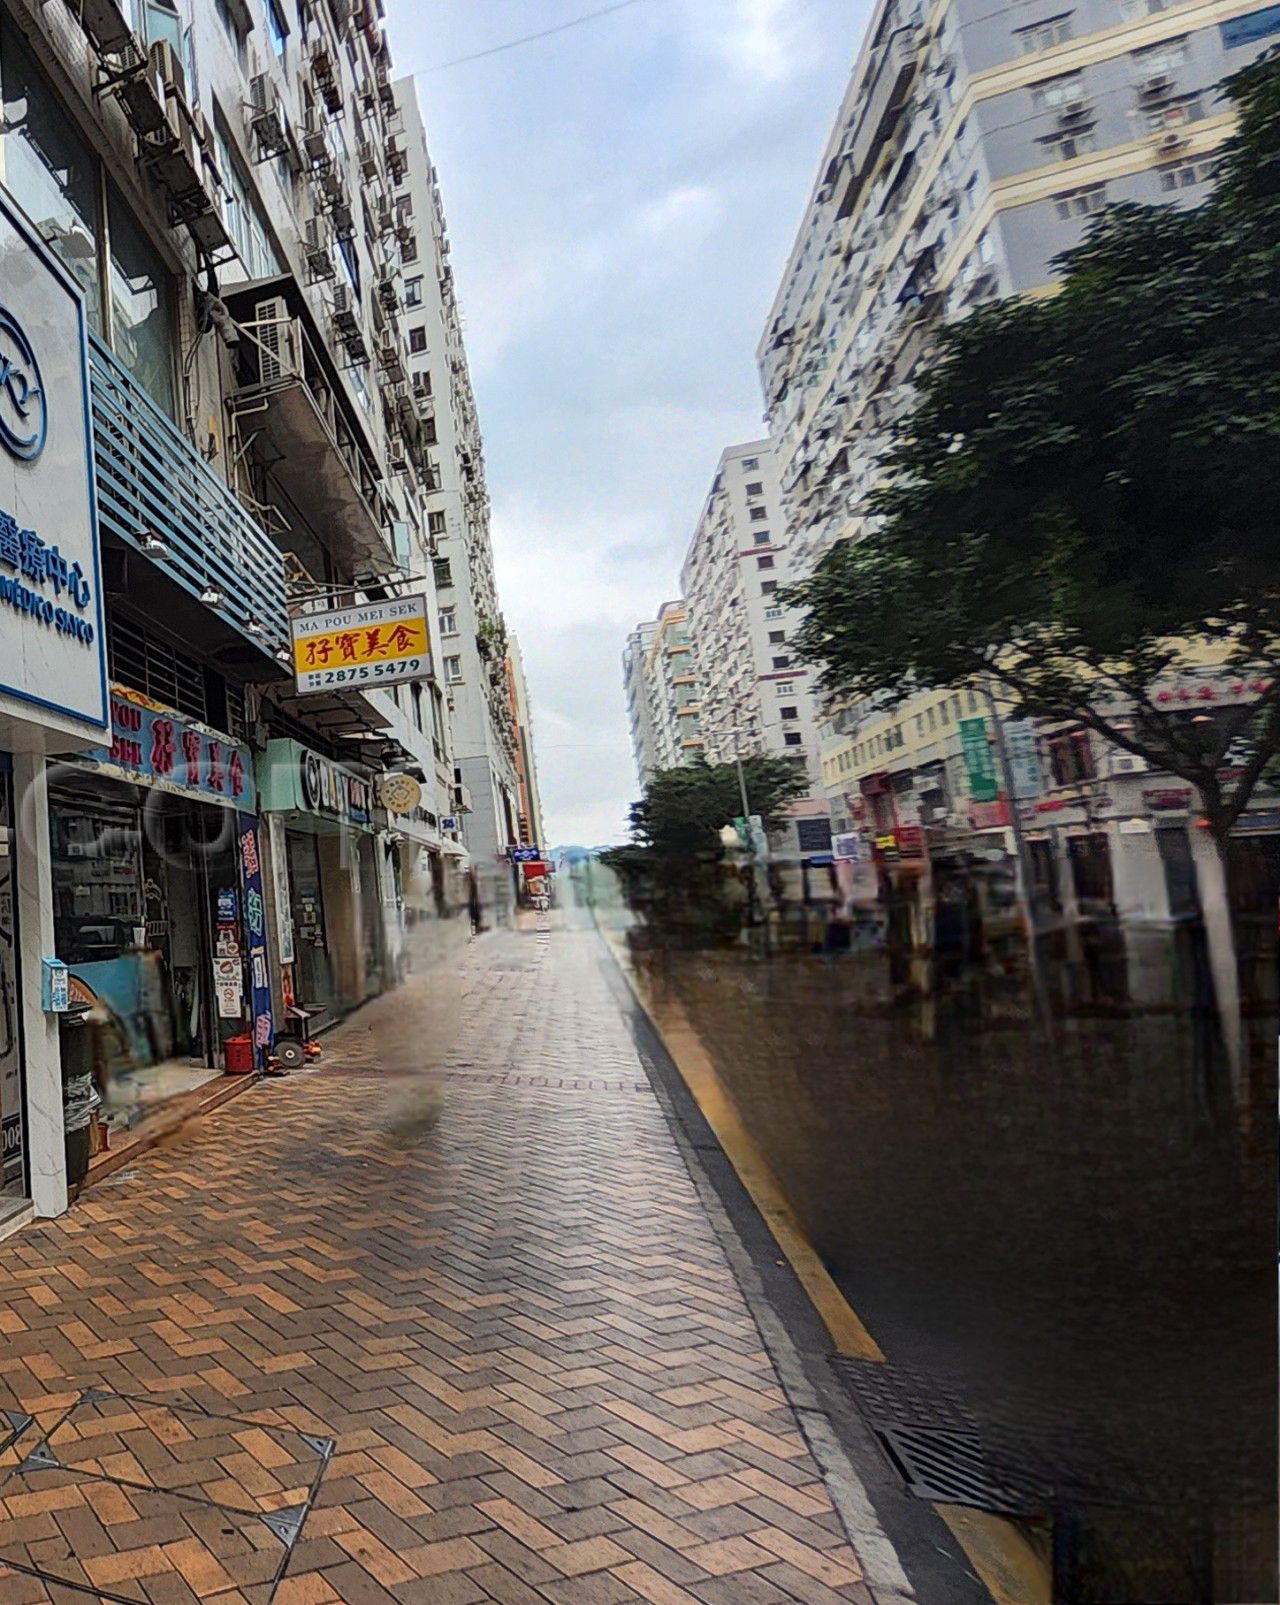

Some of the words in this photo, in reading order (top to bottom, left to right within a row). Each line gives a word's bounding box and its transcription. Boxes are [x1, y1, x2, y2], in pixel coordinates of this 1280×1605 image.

[299, 622, 319, 633] MA
[324, 615, 352, 628] POU
[358, 612, 384, 623] MEI
[389, 603, 418, 617] SEK
[324, 666, 369, 684] 2875
[374, 659, 421, 677] 5479
